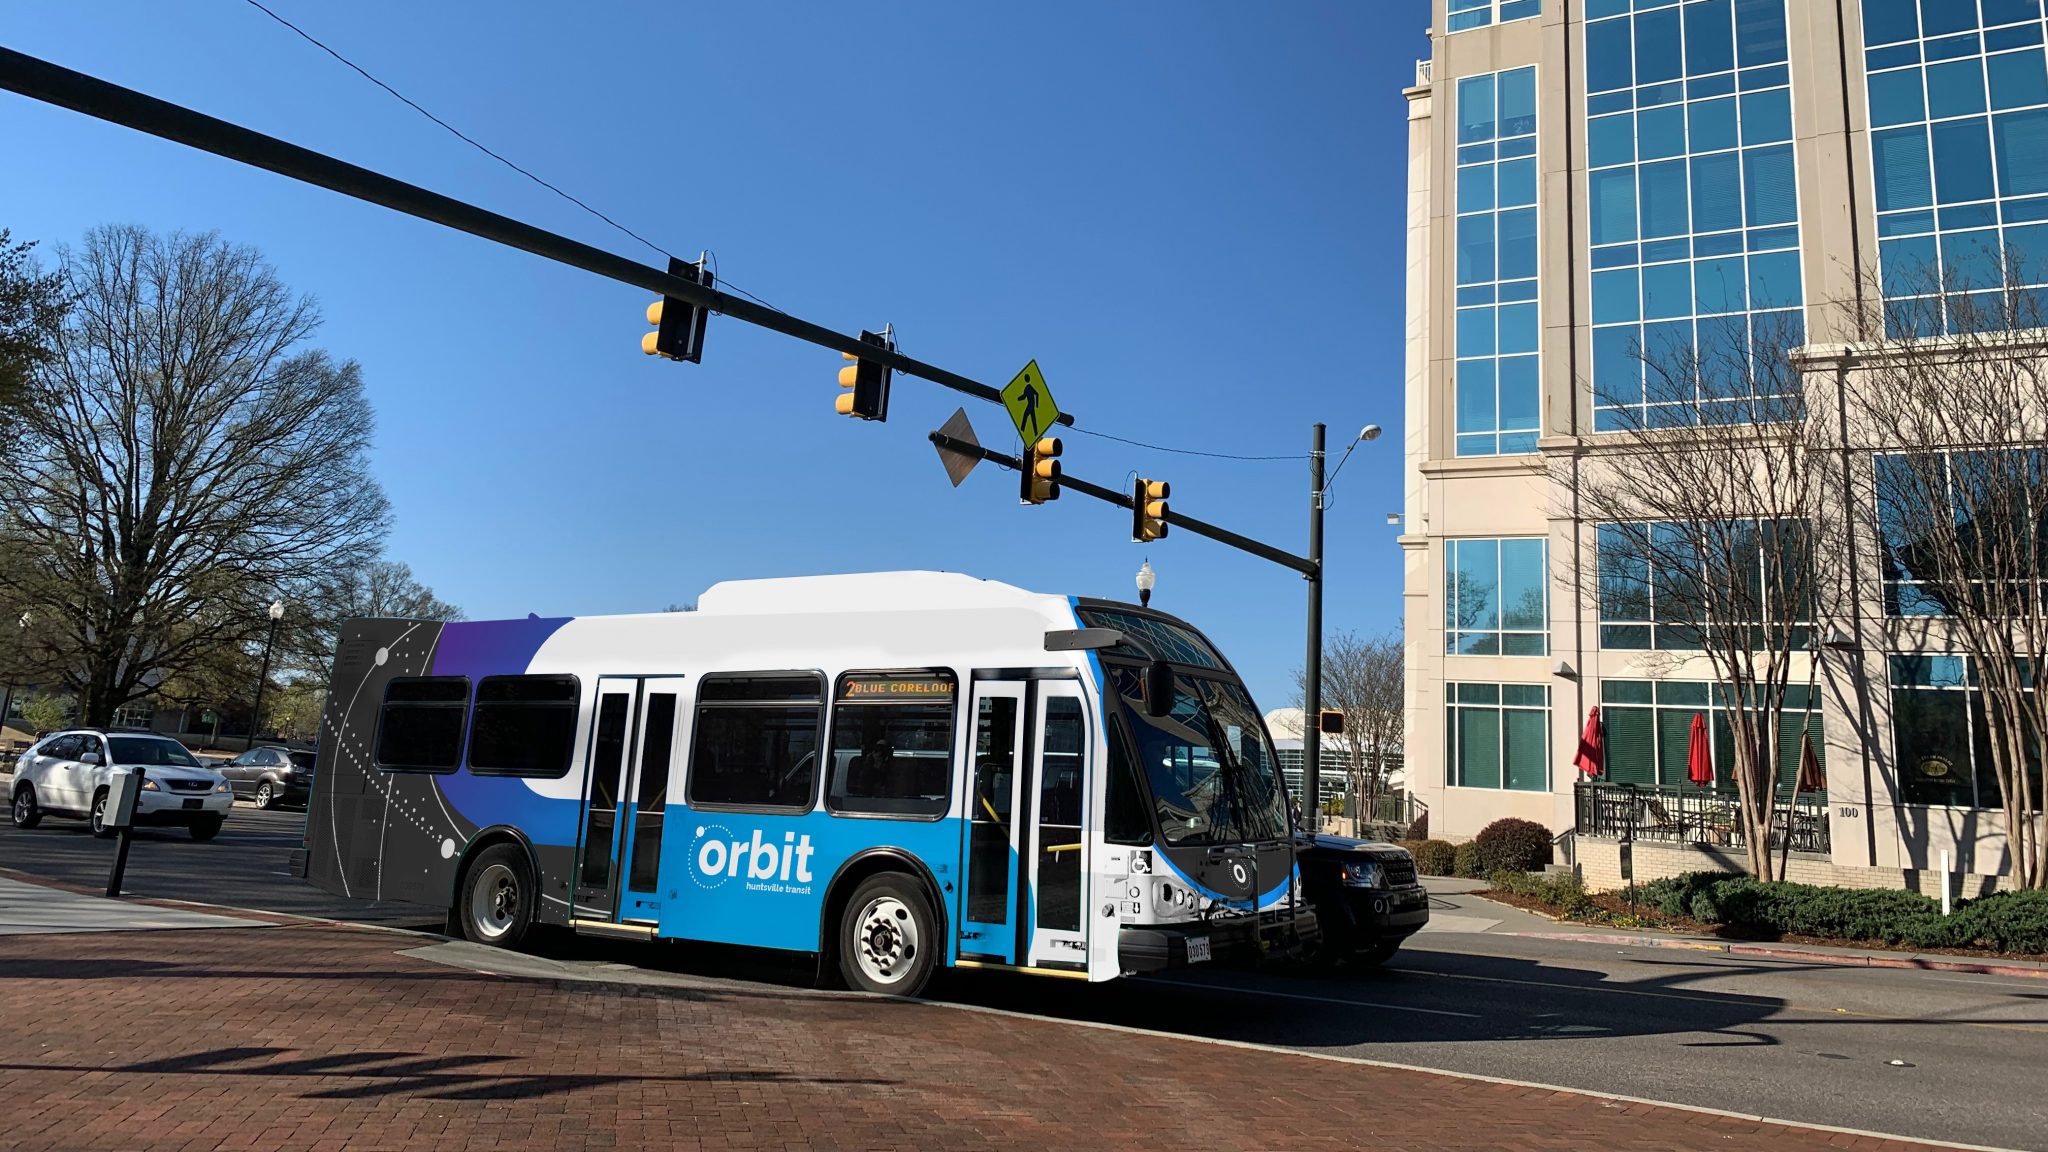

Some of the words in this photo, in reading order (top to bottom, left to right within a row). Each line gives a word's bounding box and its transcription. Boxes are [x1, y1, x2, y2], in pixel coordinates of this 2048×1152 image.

[855, 683, 887, 693] BLUE
[1838, 806, 1859, 818] 100
[699, 829, 814, 883] orbit
[746, 882, 784, 893] huntsville
[785, 884, 811, 895] transit
